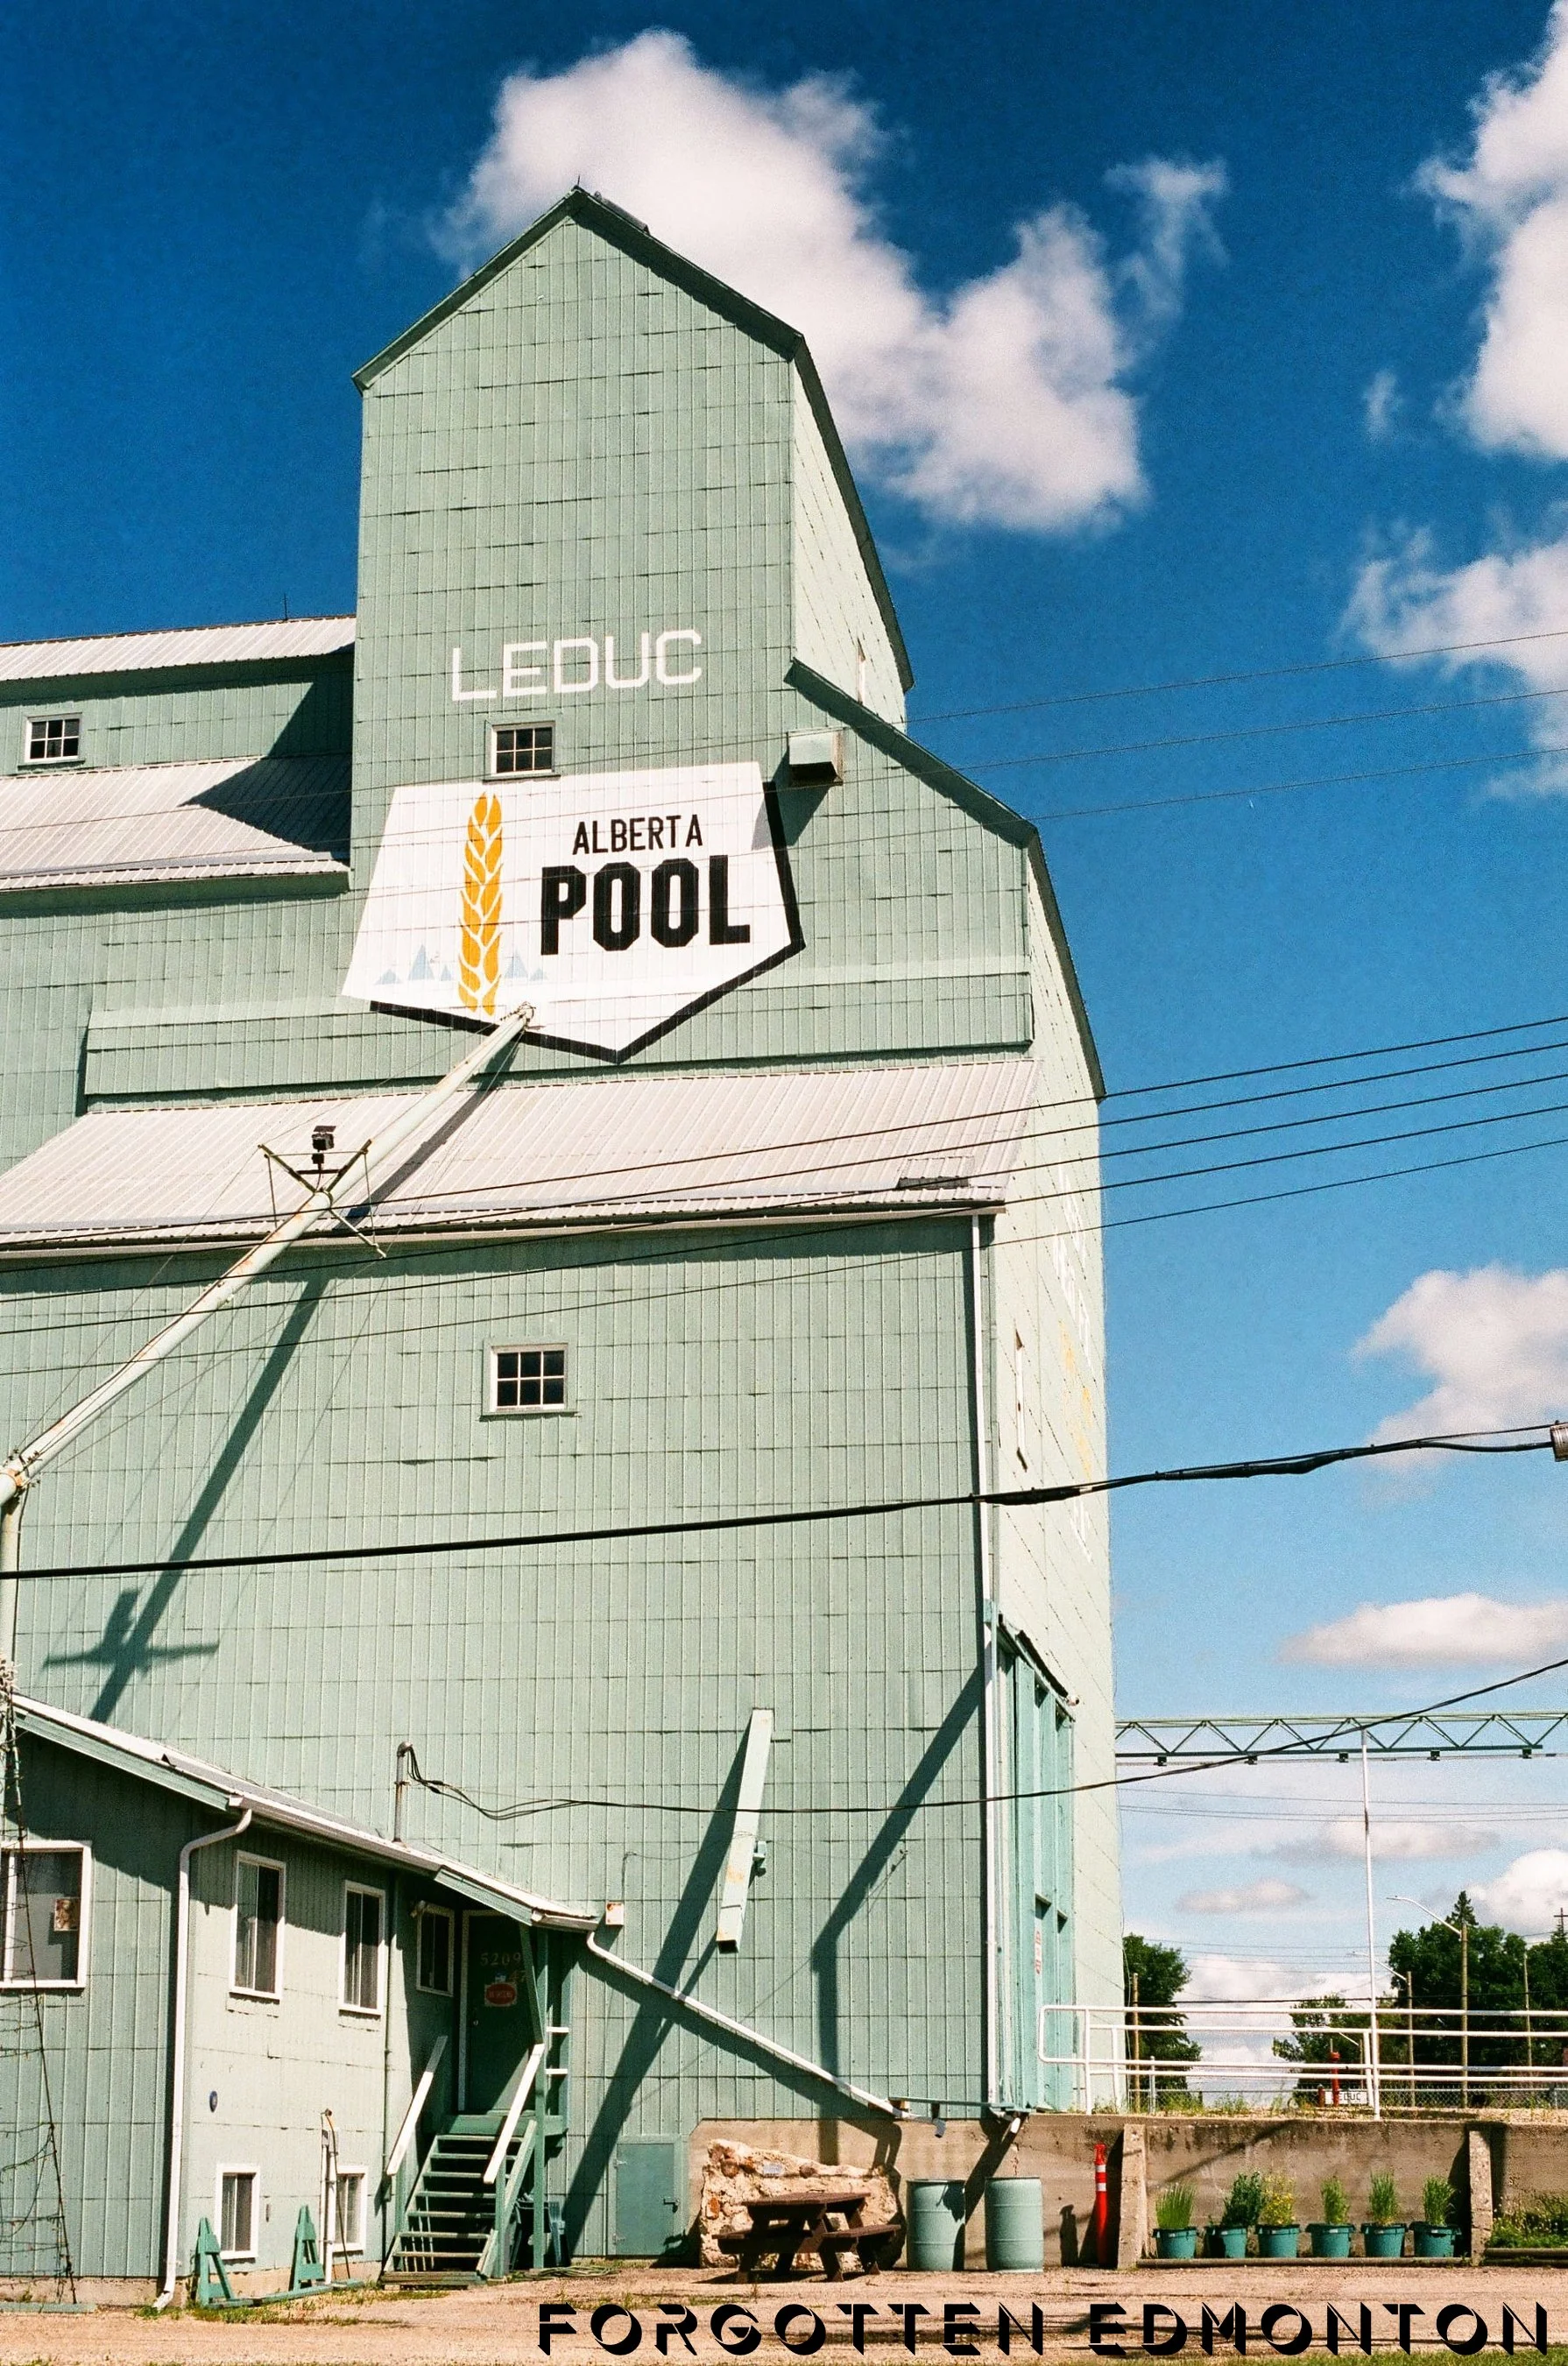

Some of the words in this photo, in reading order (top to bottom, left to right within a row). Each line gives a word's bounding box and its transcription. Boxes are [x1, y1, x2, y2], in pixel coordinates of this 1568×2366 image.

[450, 629, 703, 702] LEDUC
[572, 814, 703, 855] ALBERTA
[540, 854, 751, 956] POOL
[481, 1953, 521, 1966] 5209
[1331, 2092, 1361, 2101] EDUC
